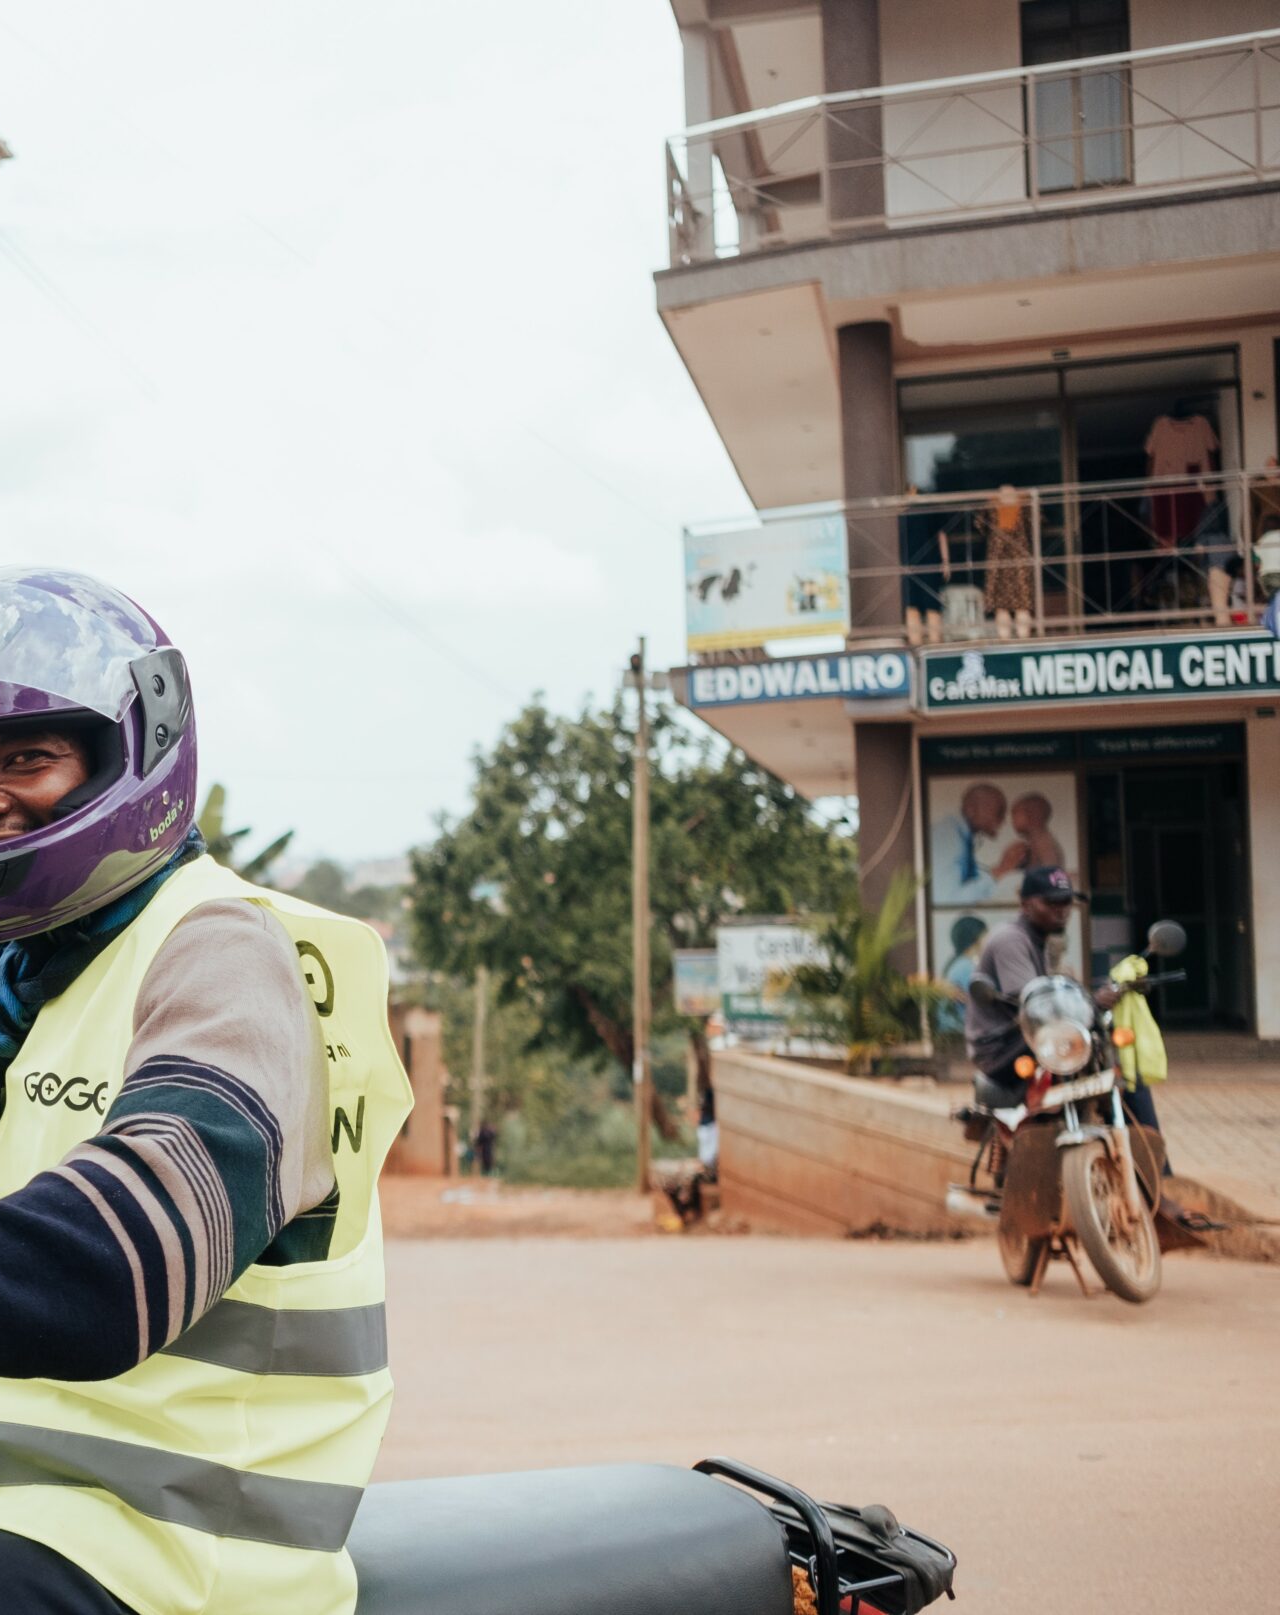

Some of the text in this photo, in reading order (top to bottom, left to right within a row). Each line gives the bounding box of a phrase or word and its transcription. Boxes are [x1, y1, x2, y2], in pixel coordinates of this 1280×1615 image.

[693, 653, 906, 703] EDDWALIRO
[929, 674, 1021, 701] CareMax
[1022, 648, 1174, 697] MEDICAL
